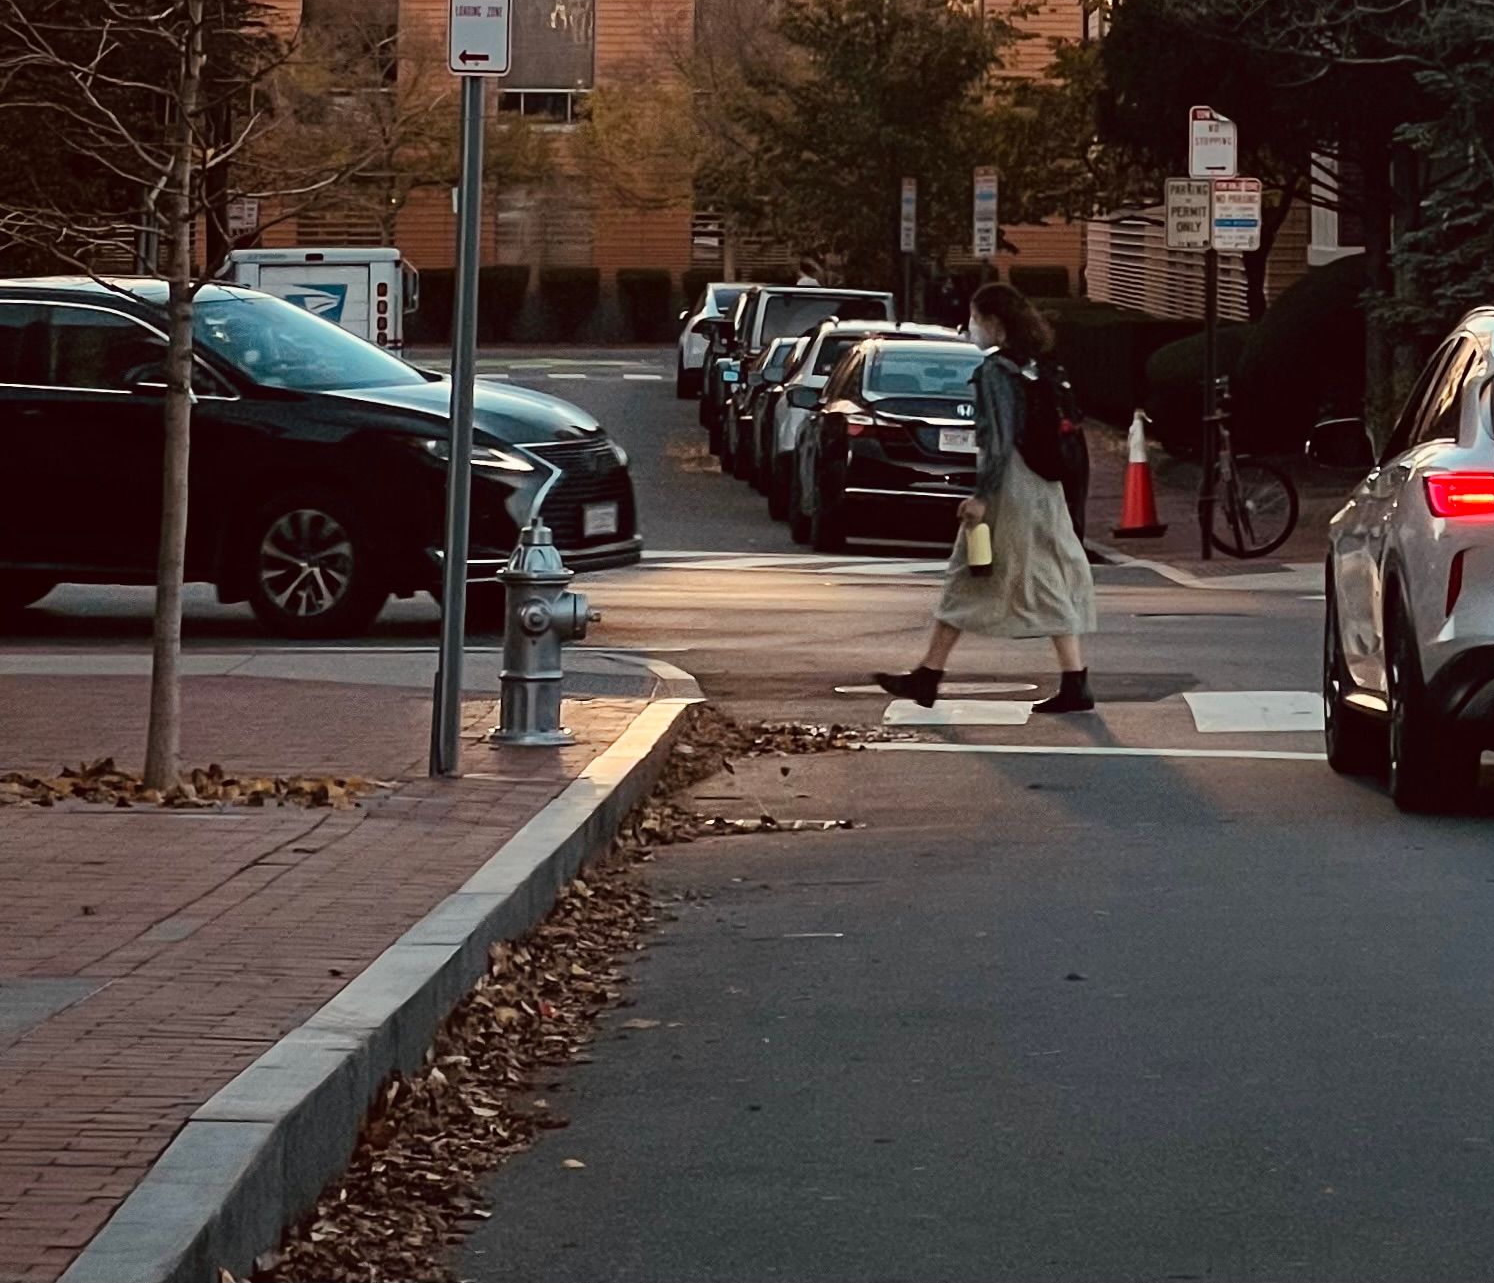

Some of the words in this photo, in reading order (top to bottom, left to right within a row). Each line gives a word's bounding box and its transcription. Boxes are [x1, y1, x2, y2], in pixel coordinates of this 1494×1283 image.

[1170, 183, 1208, 195] PARKING
[1171, 206, 1207, 218] PERMIT
[1176, 221, 1202, 232] ONLY
